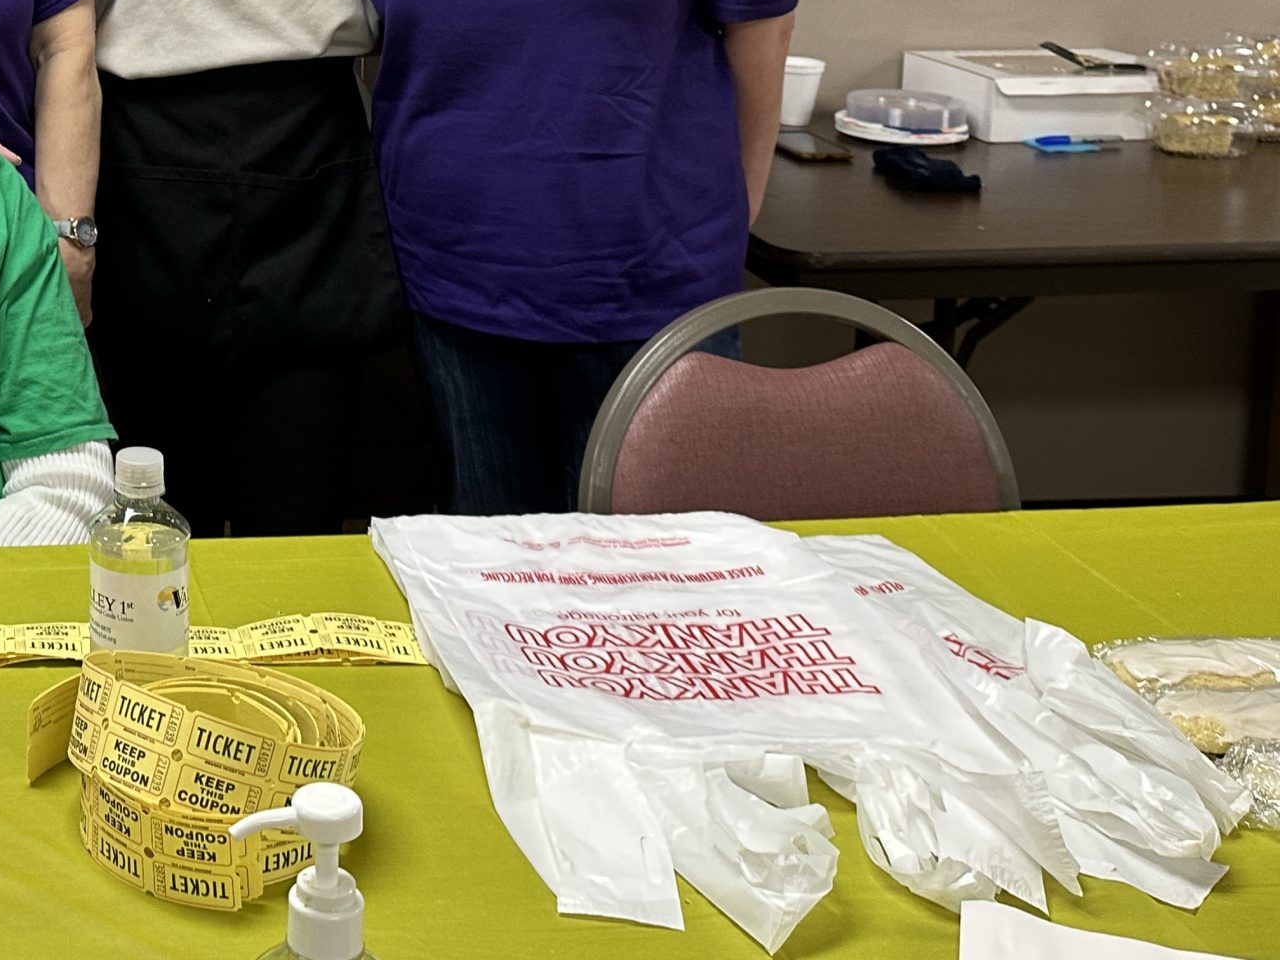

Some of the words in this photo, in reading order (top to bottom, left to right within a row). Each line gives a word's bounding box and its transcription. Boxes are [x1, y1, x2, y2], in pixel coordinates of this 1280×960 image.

[481, 572, 536, 584] RECYCLING
[536, 573, 556, 584] FOR
[670, 572, 686, 583] TO
[686, 569, 726, 583] RETURN
[725, 566, 765, 580] PLEASE
[716, 608, 742, 618] for
[505, 623, 634, 649] YOU
[623, 614, 832, 649] THANK
[29, 641, 78, 652] TICKET
[190, 647, 231, 656] TICKE
[258, 637, 308, 652] TICKET
[335, 636, 384, 650] TICKET
[521, 646, 650, 675] YOU
[638, 640, 856, 675] THANK
[656, 668, 882, 700] THANK
[119, 695, 166, 732] TICKET
[166, 709, 181, 743] 214039
[114, 739, 146, 761] KEEP
[196, 727, 256, 764] TICKET
[117, 754, 136, 768] THIS
[288, 755, 337, 780] TICKET
[102, 757, 149, 787] COUPON
[152, 758, 168, 792] 214039
[194, 772, 236, 794] KEEP
[99, 787, 139, 822] COUPON
[177, 789, 241, 815] COUPON
[200, 787, 224, 801] THIS
[104, 814, 132, 837] KEEP
[164, 824, 227, 845] COUPON
[176, 847, 217, 863] KEEP
[183, 840, 209, 851] THIS
[100, 837, 140, 879] TICKET
[263, 842, 313, 874] TICKET
[170, 873, 230, 900] TICKET
